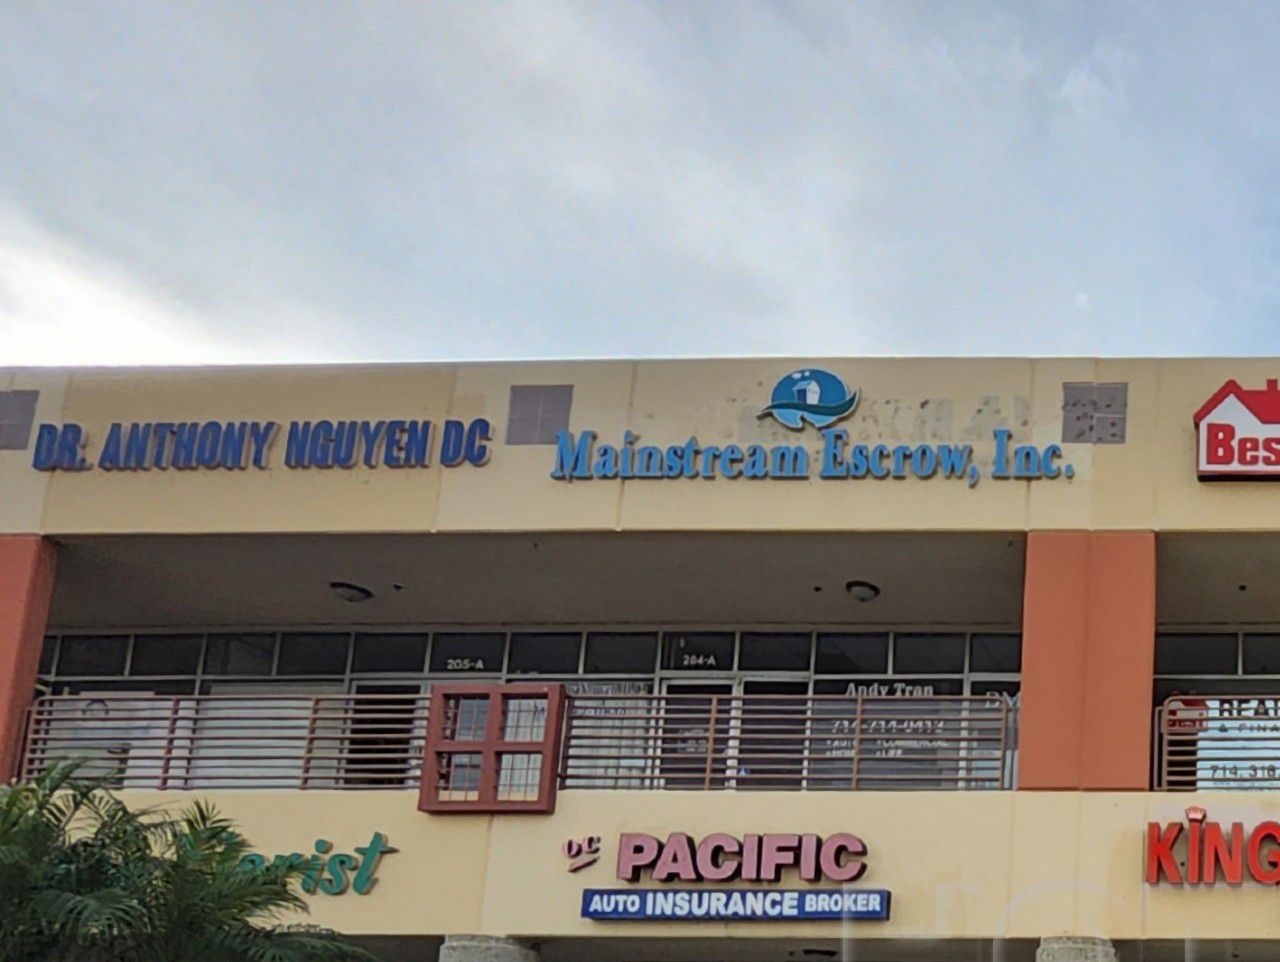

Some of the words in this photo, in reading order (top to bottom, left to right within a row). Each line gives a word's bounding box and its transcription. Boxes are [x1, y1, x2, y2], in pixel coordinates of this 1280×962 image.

[32, 423, 92, 471] DR.
[98, 420, 280, 471] ANTHONY
[284, 419, 432, 469] NGUYEN
[440, 417, 493, 467] DC
[550, 429, 809, 482] Mainstream
[819, 428, 980, 488] Escrow,
[992, 429, 1076, 481] Inc.
[616, 831, 869, 883] PACIFIC
[589, 894, 640, 912] AUTO
[646, 891, 799, 917] INSURANCE
[804, 894, 881, 912] BROKER
